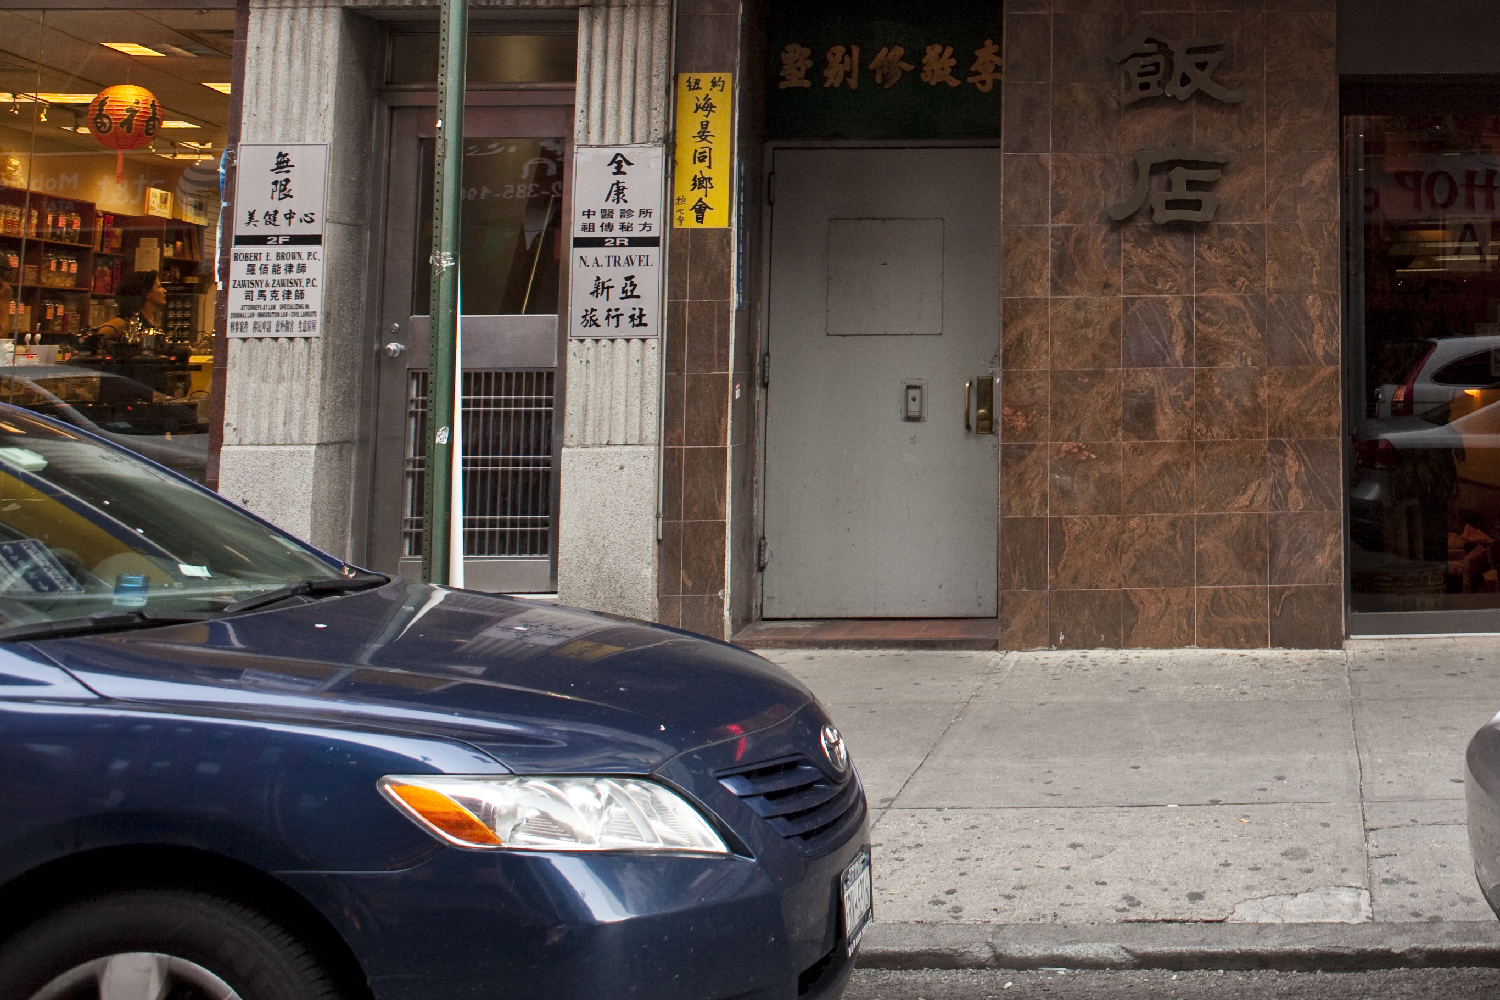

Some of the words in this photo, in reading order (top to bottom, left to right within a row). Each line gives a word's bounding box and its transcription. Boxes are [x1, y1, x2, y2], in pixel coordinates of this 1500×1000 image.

[686, 76, 726, 93] 紐約
[270, 151, 295, 201] 無限
[604, 152, 634, 204] 全康
[244, 209, 316, 227] 美健中心
[582, 208, 653, 219] 中醫診所
[580, 222, 653, 233] 祖傳秘方
[266, 236, 291, 245] 2F
[604, 238, 629, 246] 2R
[233, 252, 262, 262] ROBERT
[605, 254, 653, 268] TRAVEL
[589, 274, 641, 301] 新亞
[244, 289, 305, 301] 司馬克律師
[580, 307, 648, 328] 旅行社
